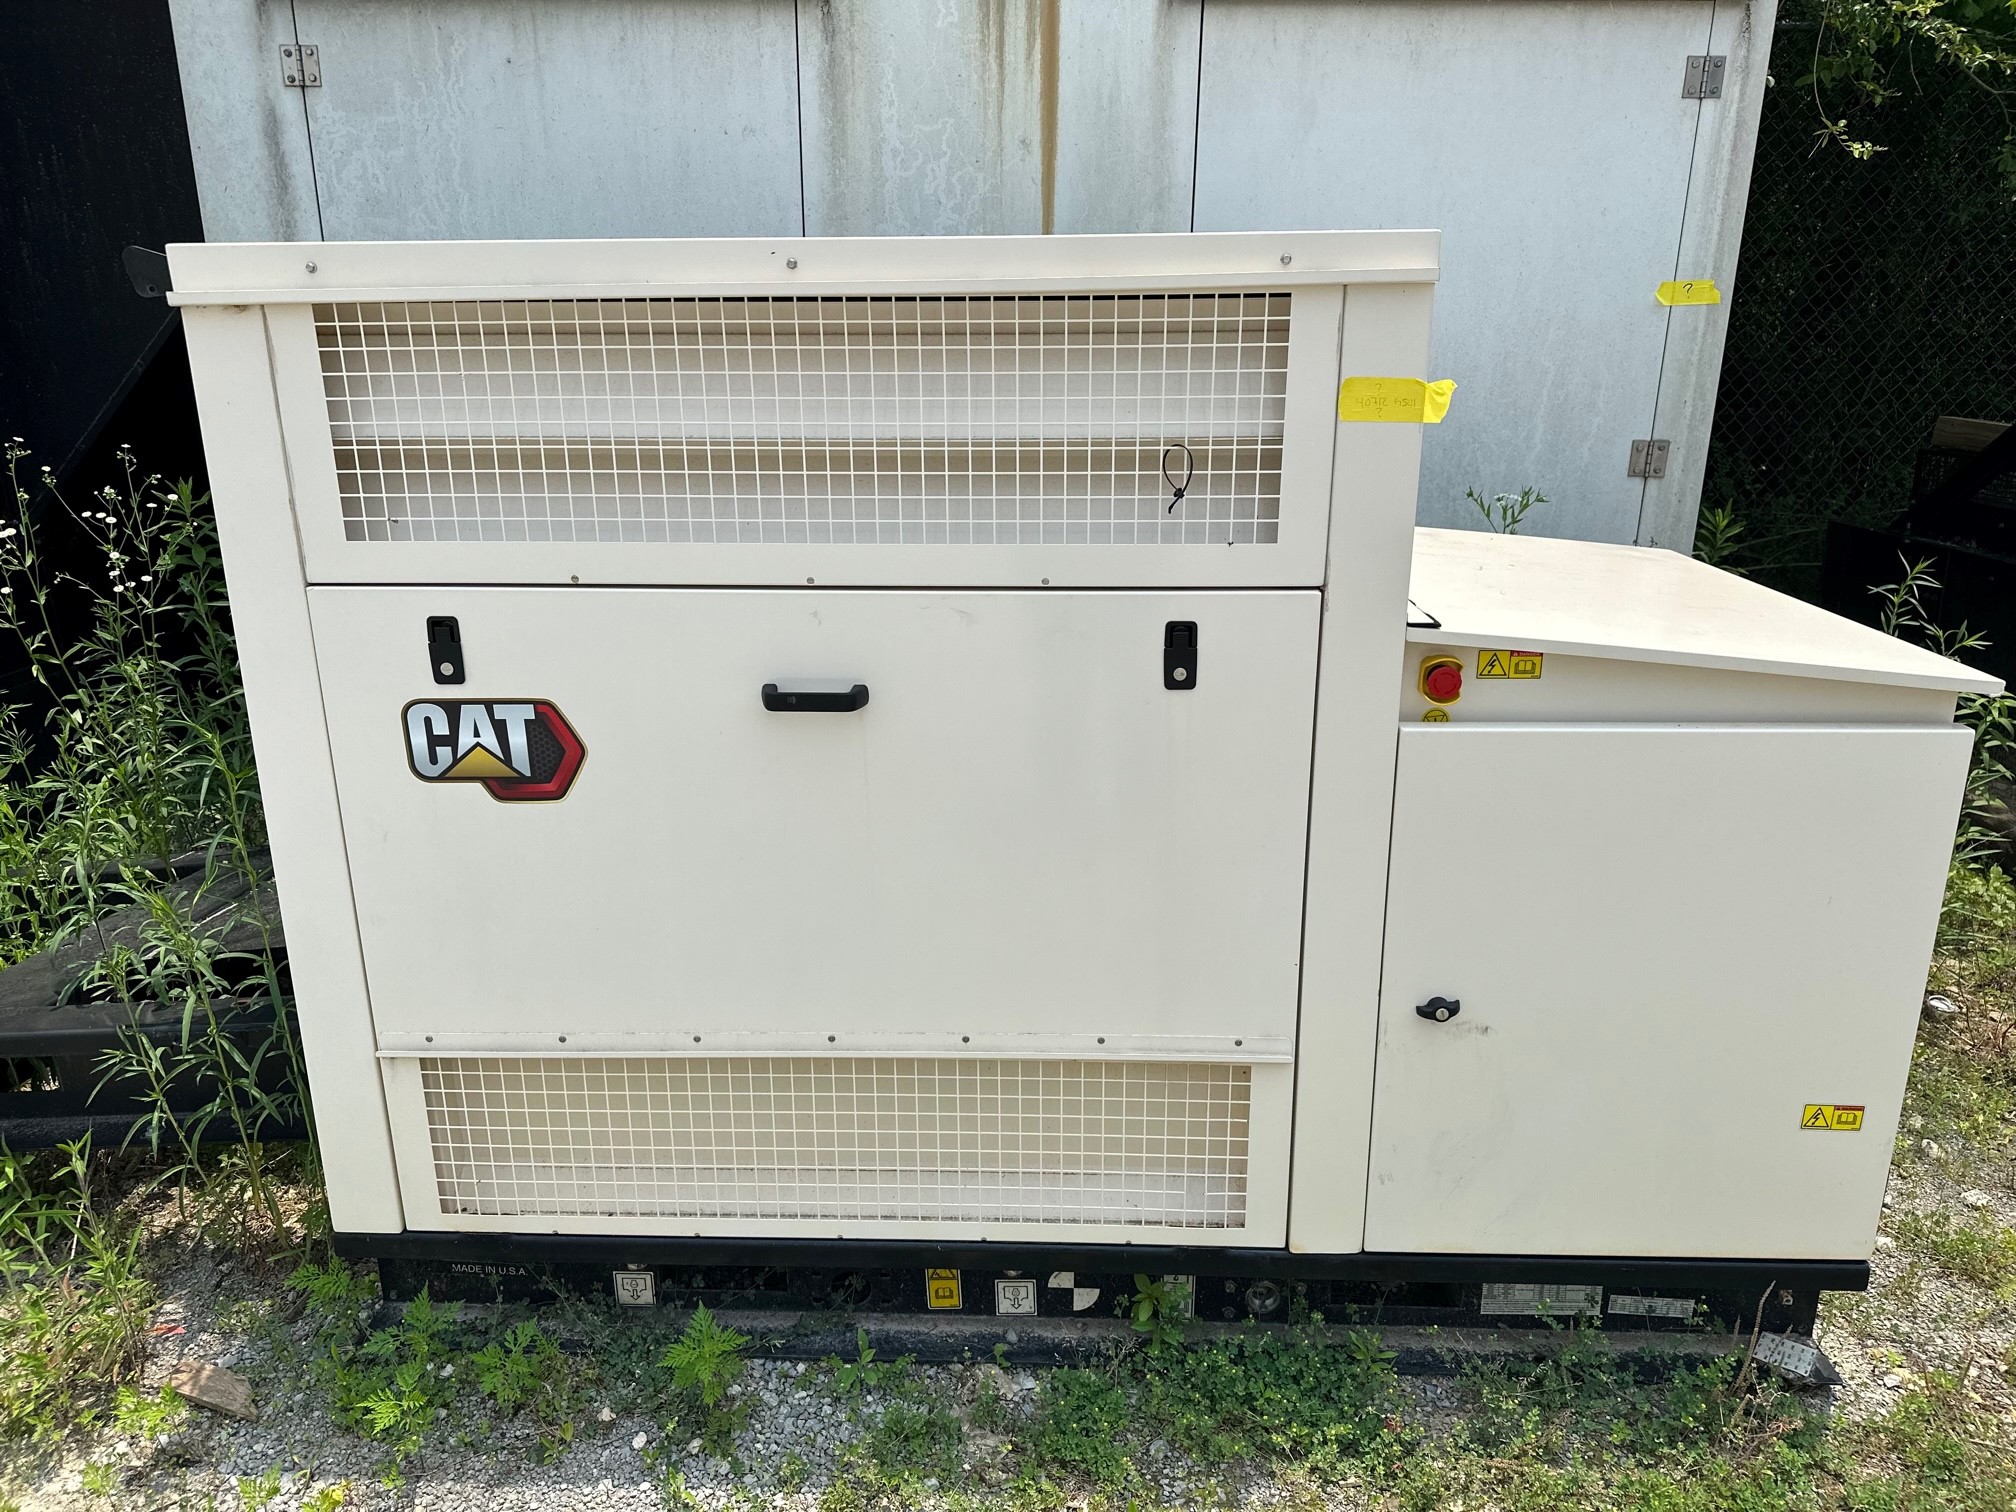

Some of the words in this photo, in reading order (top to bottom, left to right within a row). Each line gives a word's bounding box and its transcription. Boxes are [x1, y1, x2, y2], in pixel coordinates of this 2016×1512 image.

[1683, 283, 1693, 299] ?
[407, 703, 536, 777] CAT
[452, 1263, 483, 1273] MADE
[485, 1265, 496, 1274] IN
[498, 1266, 528, 1276] U.S.A.
